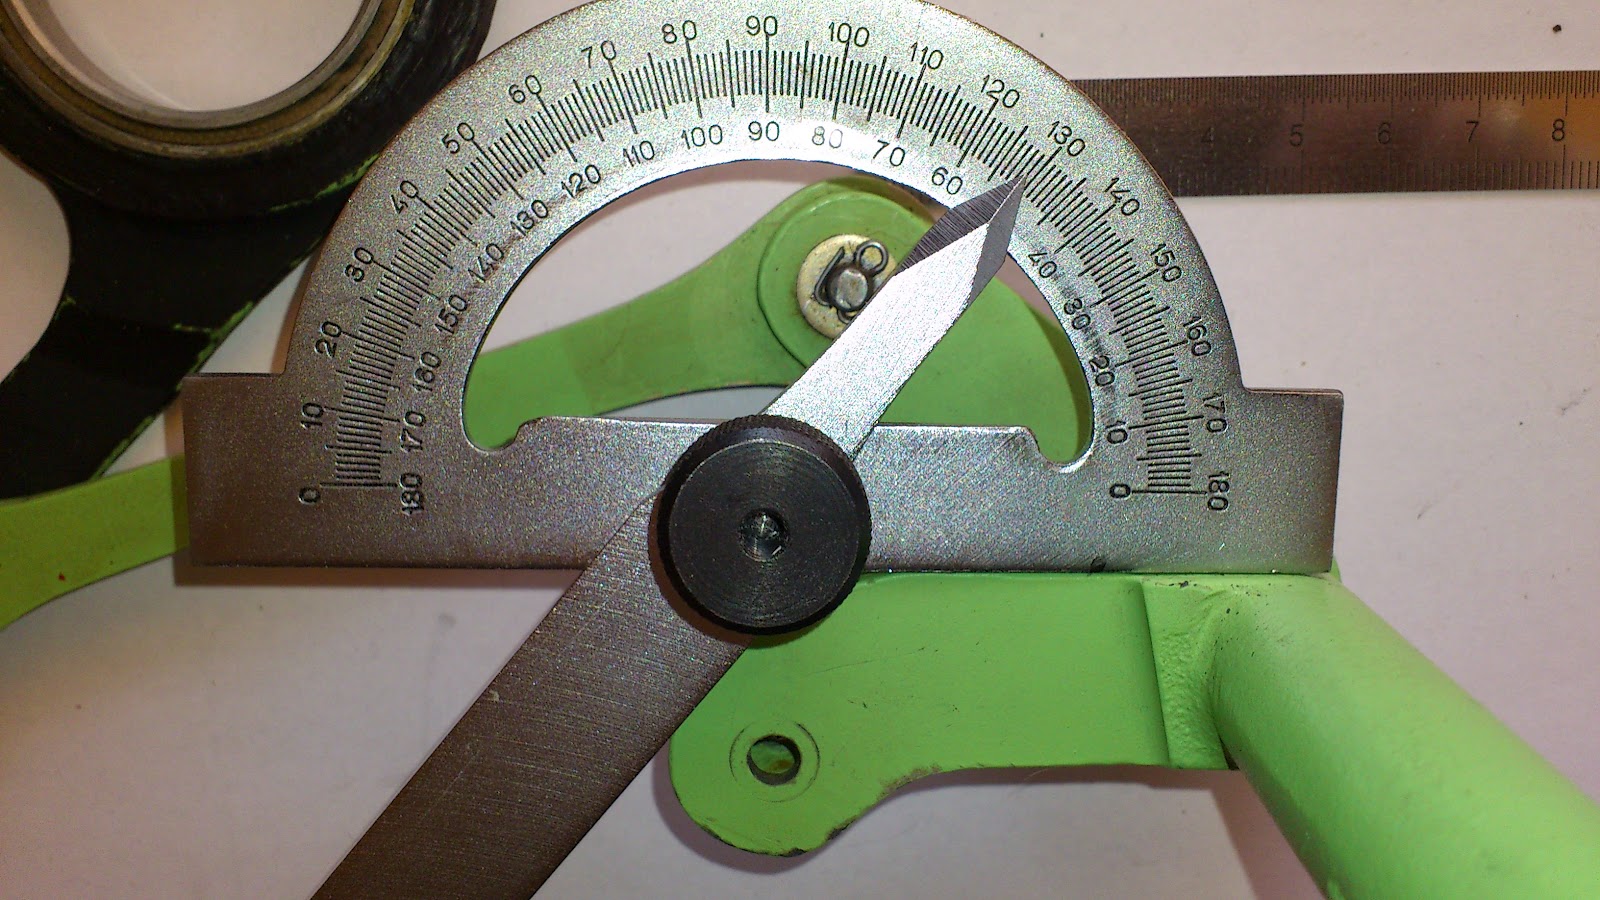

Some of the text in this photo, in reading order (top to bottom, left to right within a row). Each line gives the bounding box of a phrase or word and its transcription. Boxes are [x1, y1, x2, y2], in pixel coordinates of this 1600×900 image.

[299, 15, 1230, 512] 0 10 20 30 40 50 60 70 80 90 100 110 120 130 140 150 160 170 180
[400, 121, 1131, 516] 180 170 160 150 140 130 120 110 100 90 80 70 60 40 30 20 10 0
[1289, 124, 1304, 147] 5
[1377, 122, 1391, 144] 6
[1466, 120, 1480, 143] 7
[1552, 118, 1565, 142] 8
